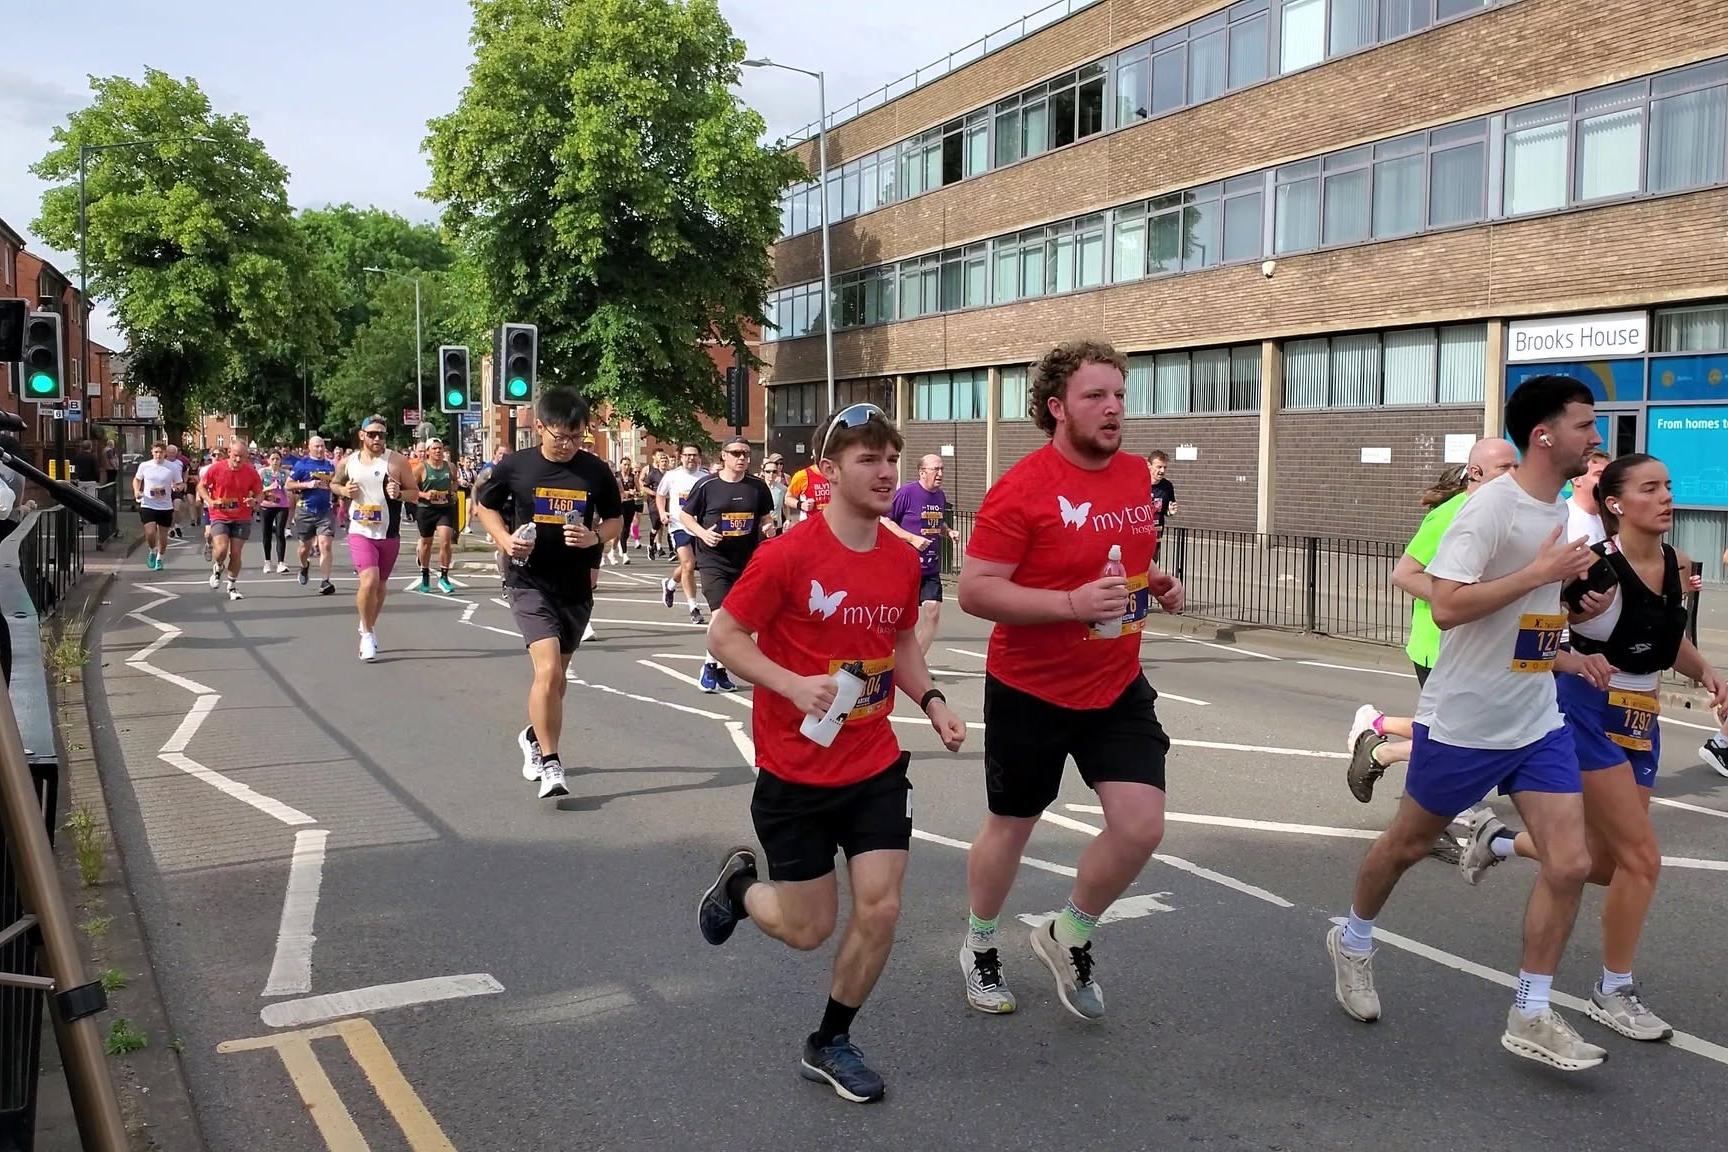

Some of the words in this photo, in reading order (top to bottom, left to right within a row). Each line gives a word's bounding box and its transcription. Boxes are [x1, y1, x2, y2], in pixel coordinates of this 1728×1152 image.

[1515, 329, 1574, 352] Brooks
[1580, 326, 1640, 348] House
[1657, 418, 1683, 430] From
[1685, 417, 1720, 430] homes
[1722, 418, 1728, 429] t
[548, 498, 574, 512] 1460
[730, 519, 747, 528] 5057
